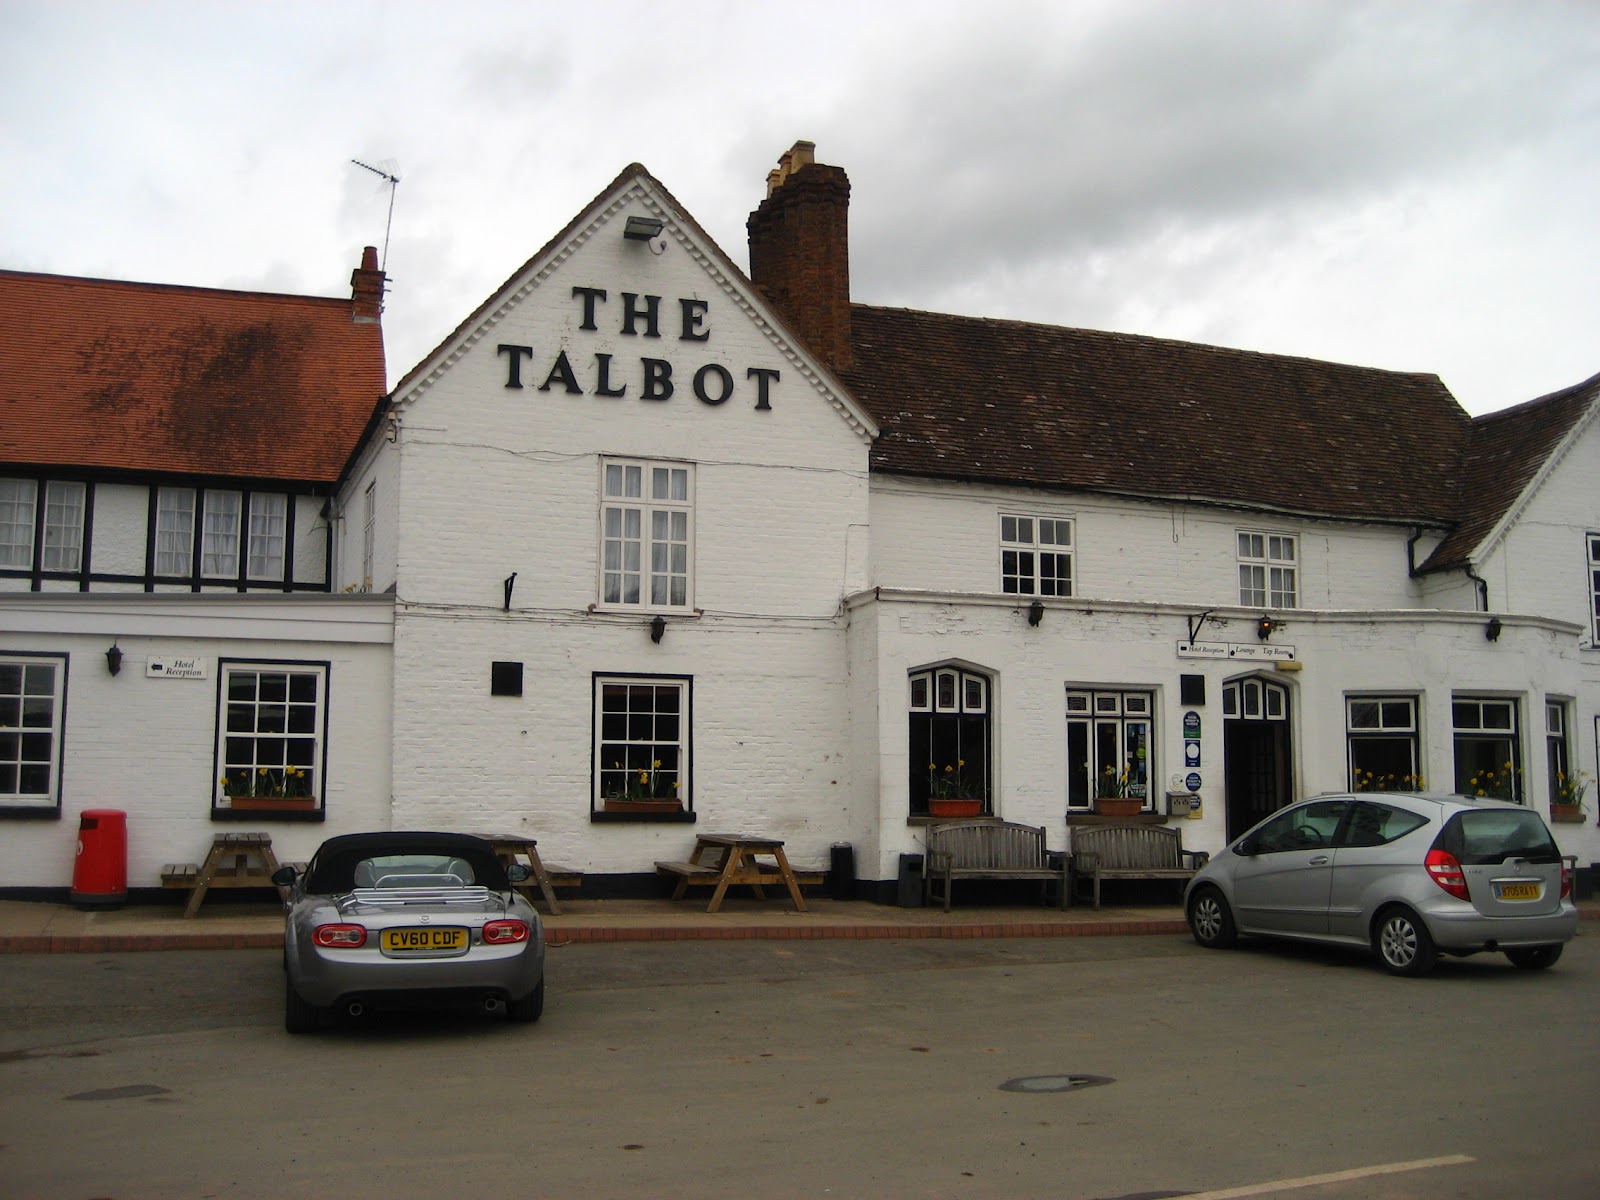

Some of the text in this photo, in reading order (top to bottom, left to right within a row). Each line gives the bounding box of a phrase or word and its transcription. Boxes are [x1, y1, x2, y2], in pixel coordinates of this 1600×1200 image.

[572, 286, 711, 342] THE
[497, 343, 780, 411] TALBOT
[1235, 646, 1255, 654] Lounge
[1262, 647, 1273, 655] Tap
[174, 660, 194, 668] Hotel
[166, 667, 202, 677] Reception
[390, 931, 461, 946] CV60 CDF
